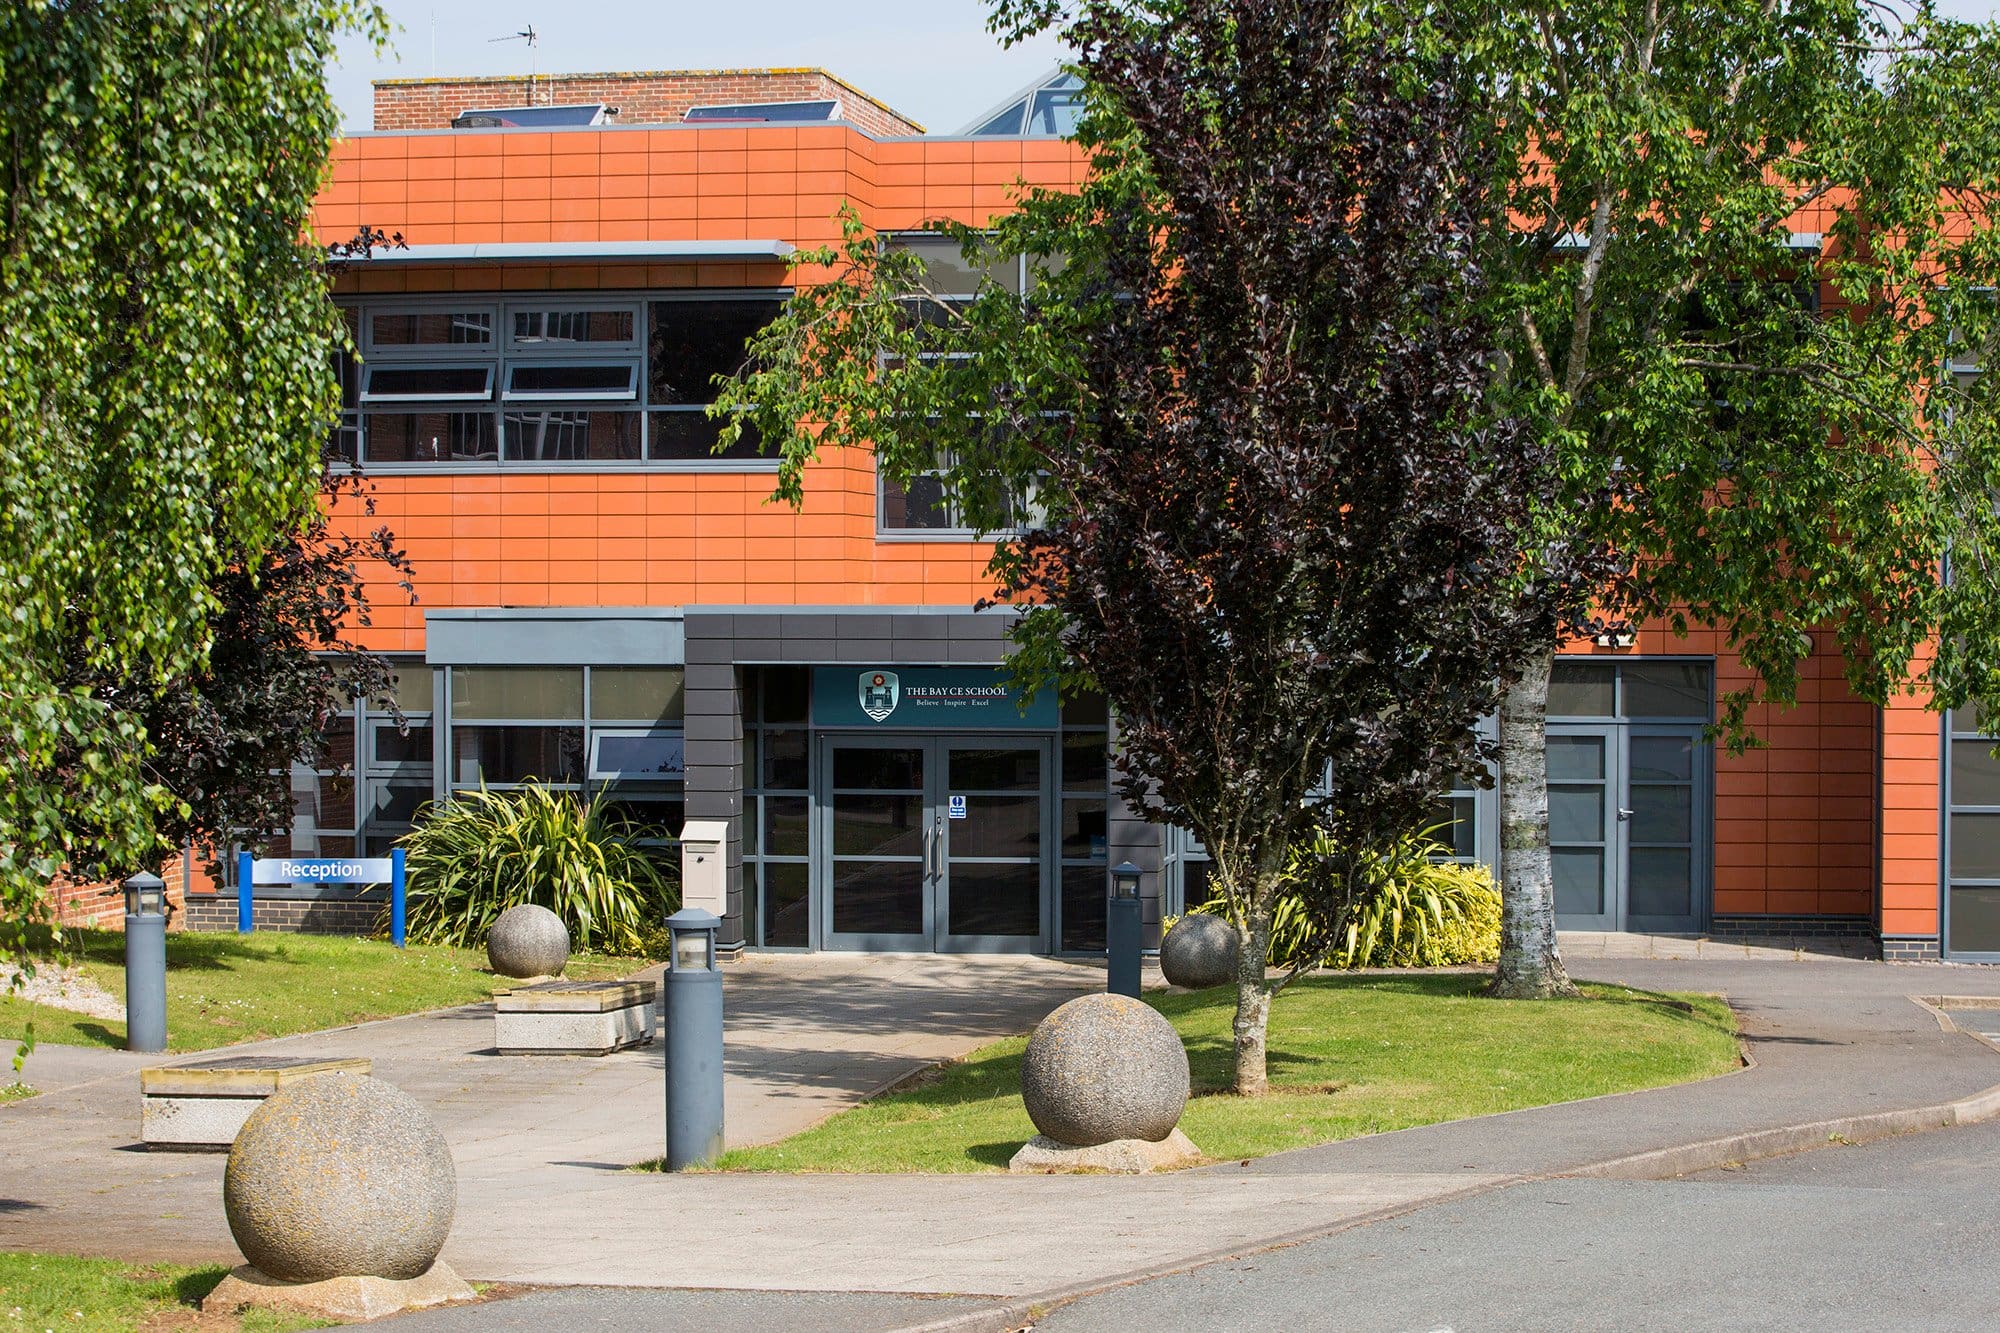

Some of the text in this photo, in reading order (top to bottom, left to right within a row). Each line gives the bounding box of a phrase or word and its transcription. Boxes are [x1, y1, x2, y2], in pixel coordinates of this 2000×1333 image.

[906, 687, 1007, 696] THE BAY CE SCHOOL
[944, 699, 966, 708] Inspire
[281, 861, 363, 881] Reception
